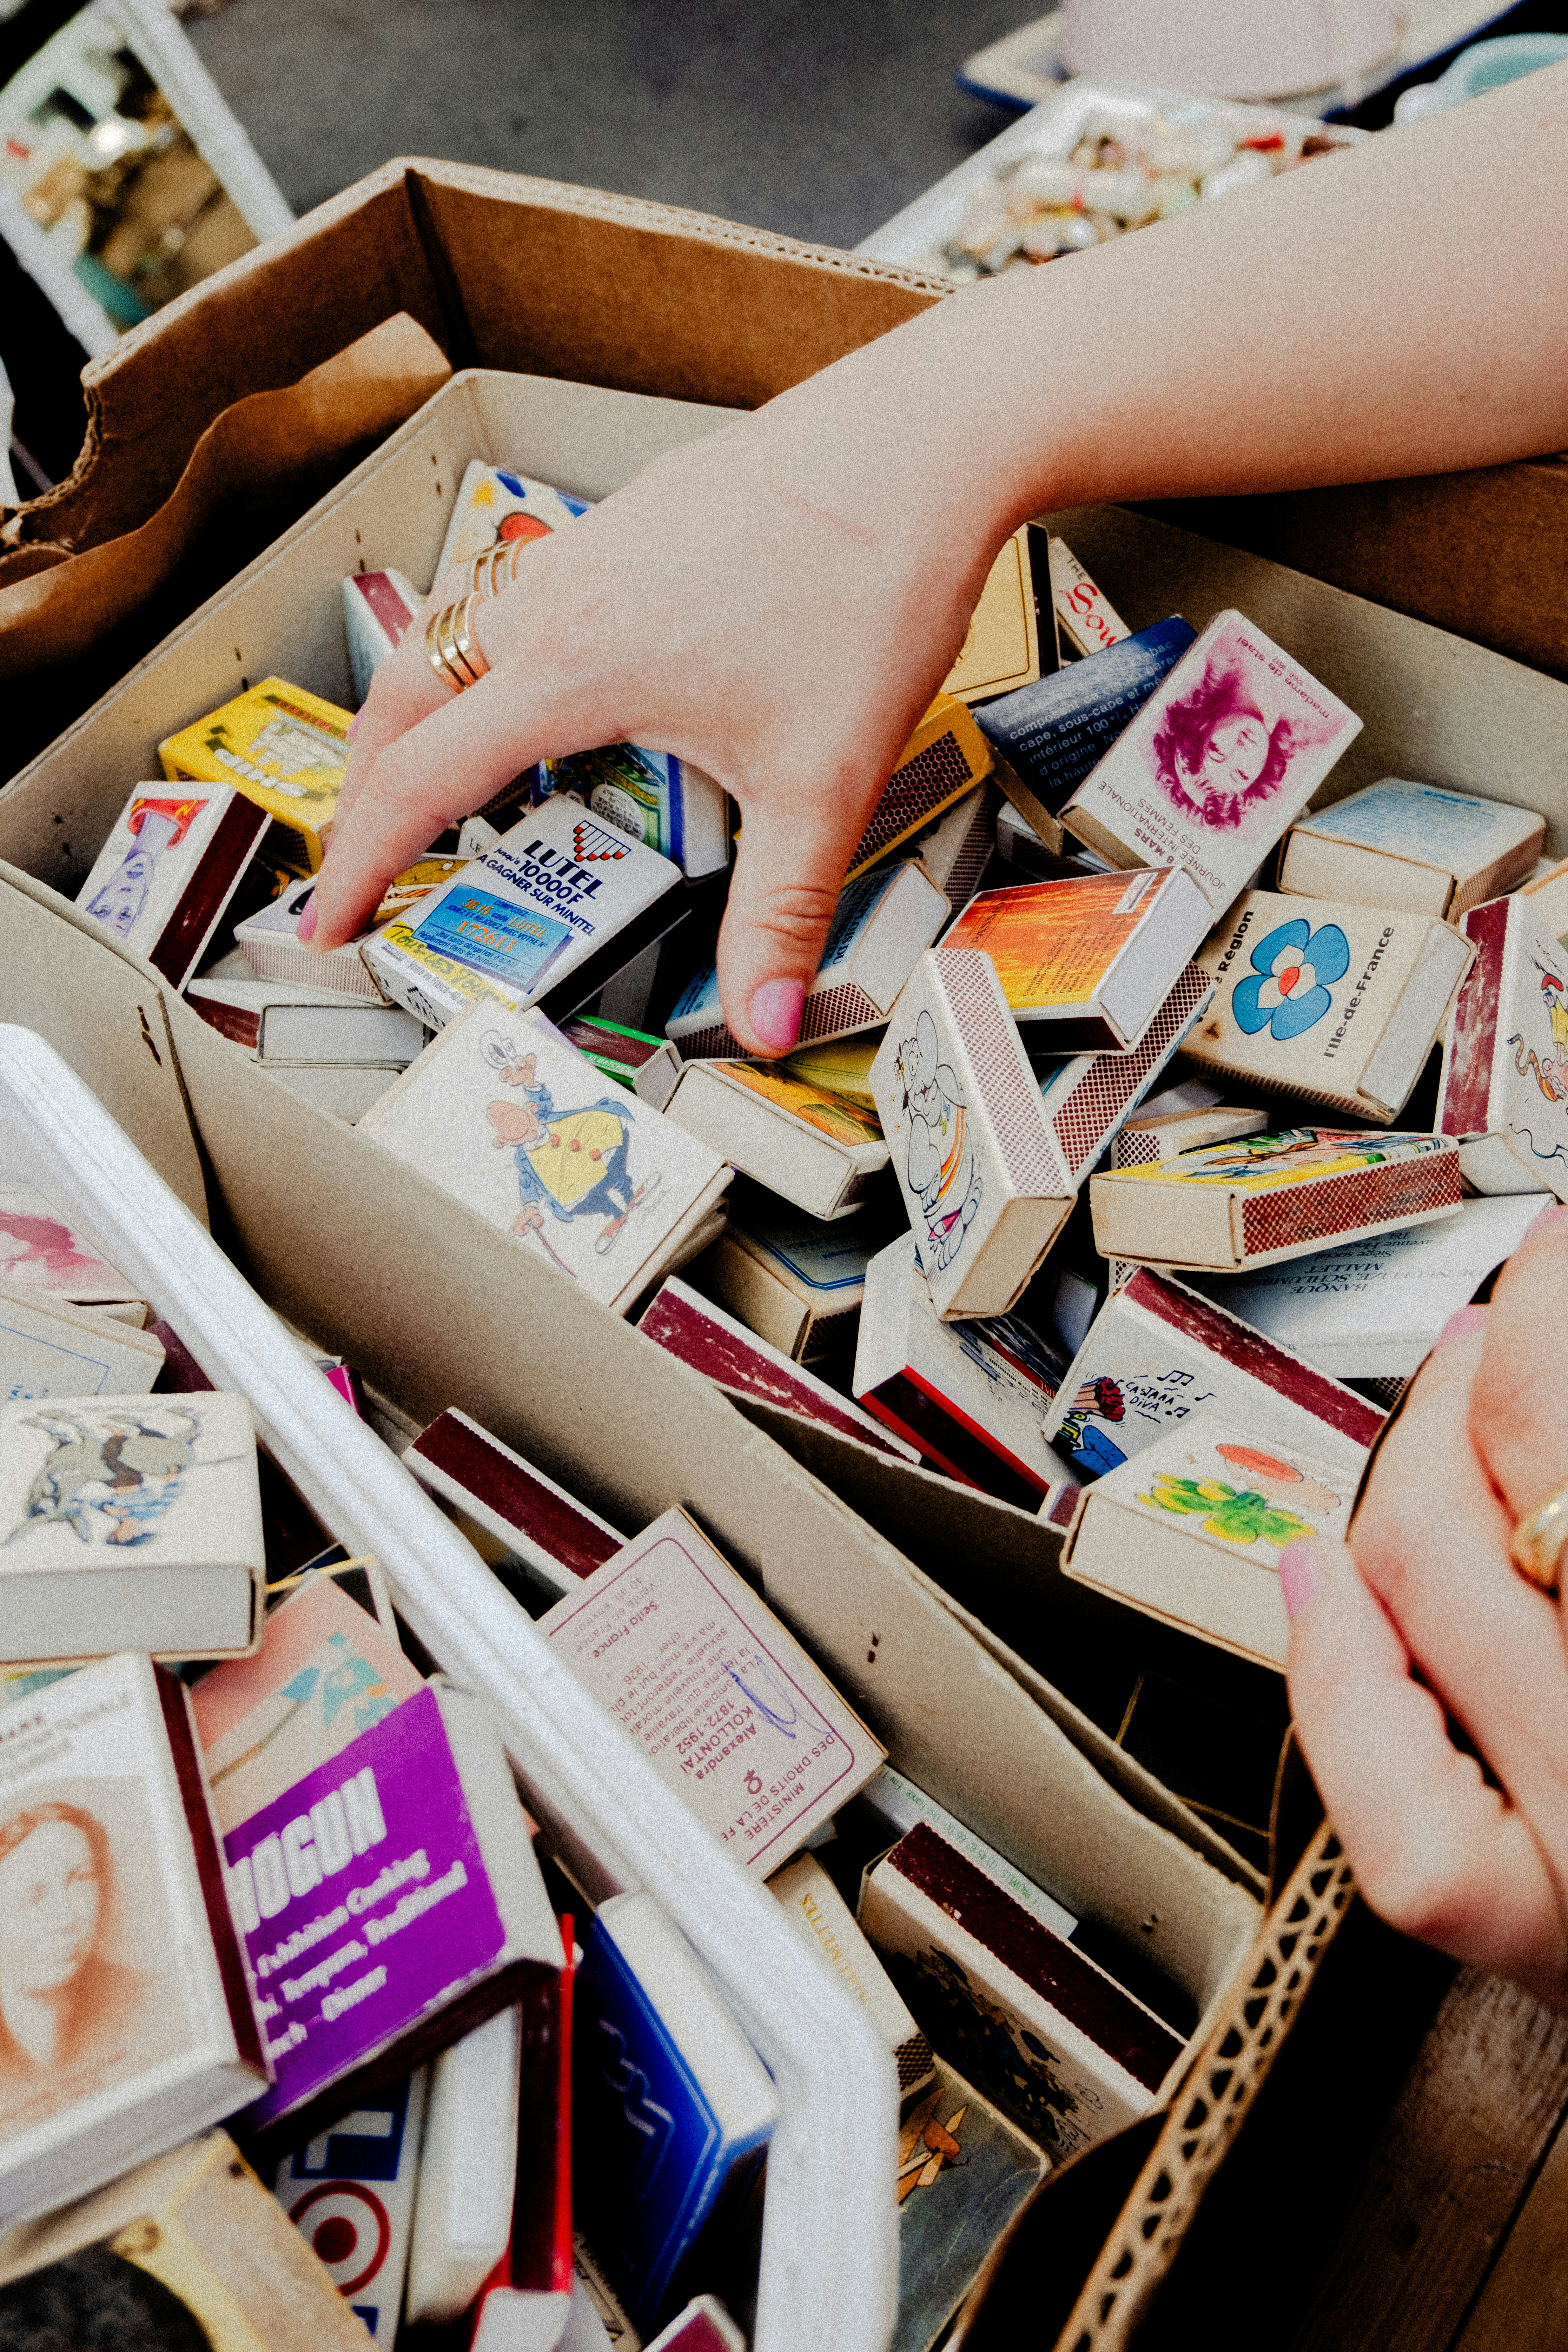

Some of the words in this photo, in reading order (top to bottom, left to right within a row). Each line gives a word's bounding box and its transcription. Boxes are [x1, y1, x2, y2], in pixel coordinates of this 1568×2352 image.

[1065, 557, 1086, 580] THE
[1265, 661, 1284, 678] de
[1282, 676, 1331, 719] madame
[1019, 727, 1057, 754] cape,
[1058, 695, 1125, 734] sous-cape
[1126, 686, 1140, 700] et
[1027, 731, 1084, 764] intérieur
[1038, 739, 1102, 779] d'origine.
[1048, 775, 1063, 789] la
[1096, 780, 1180, 852] INTERNATIONALE
[1135, 796, 1180, 837] FEMMES
[1132, 826, 1166, 857] MARS
[1178, 833, 1202, 855] DES
[522, 836, 605, 900] LUTEL
[1164, 854, 1176, 864] 8
[476, 851, 488, 864] A
[485, 857, 532, 894] GAGNER
[529, 886, 555, 908] SUR
[551, 900, 596, 937] MINITEL
[445, 902, 467, 916] JOUEZ
[464, 910, 476, 920] ET
[474, 914, 503, 931] REJOUEZ
[500, 925, 520, 938] AVEC
[517, 932, 540, 946] VOTRE
[455, 918, 517, 955] 172611
[490, 910, 509, 924] code
[507, 914, 547, 940] LUTEL
[435, 928, 451, 942] Jeu
[448, 934, 464, 947] sans
[461, 940, 495, 962] obligation
[449, 941, 466, 956] dans
[465, 948, 476, 960] les
[832, 943, 849, 967] DU
[596, 1056, 633, 1073] MATCHES
[1314, 1251, 1352, 1261] social
[1356, 1247, 1395, 1259] Siège
[1303, 1261, 1384, 1276] MALLET
[1288, 1281, 1368, 1296] BANQUE
[628, 1600, 659, 1628] Seita
[697, 1619, 717, 1637] ma
[574, 1621, 612, 1654] France
[591, 1624, 631, 1659] France
[681, 1635, 699, 1652] vie
[685, 1626, 728, 1667] sexuelle
[656, 1650, 683, 1673] mon
[704, 1646, 728, 1667] une
[622, 1660, 649, 1686] 1926
[637, 1670, 659, 1690] but
[662, 1665, 708, 1706] nouvelle
[701, 1656, 739, 1690] femme
[625, 1687, 640, 1701] le
[635, 1667, 683, 1711] resteront
[682, 1686, 702, 1704] qui
[642, 1703, 684, 1743] travaille
[674, 1698, 735, 1756] 1872-1952
[694, 1722, 759, 1782] Alexandra
[810, 1734, 835, 1759] DES
[768, 1755, 812, 1797] DROITS
[743, 1782, 806, 1841] MINISTÈRE
[751, 1794, 770, 1813] DE
[735, 1809, 753, 1828] LA
